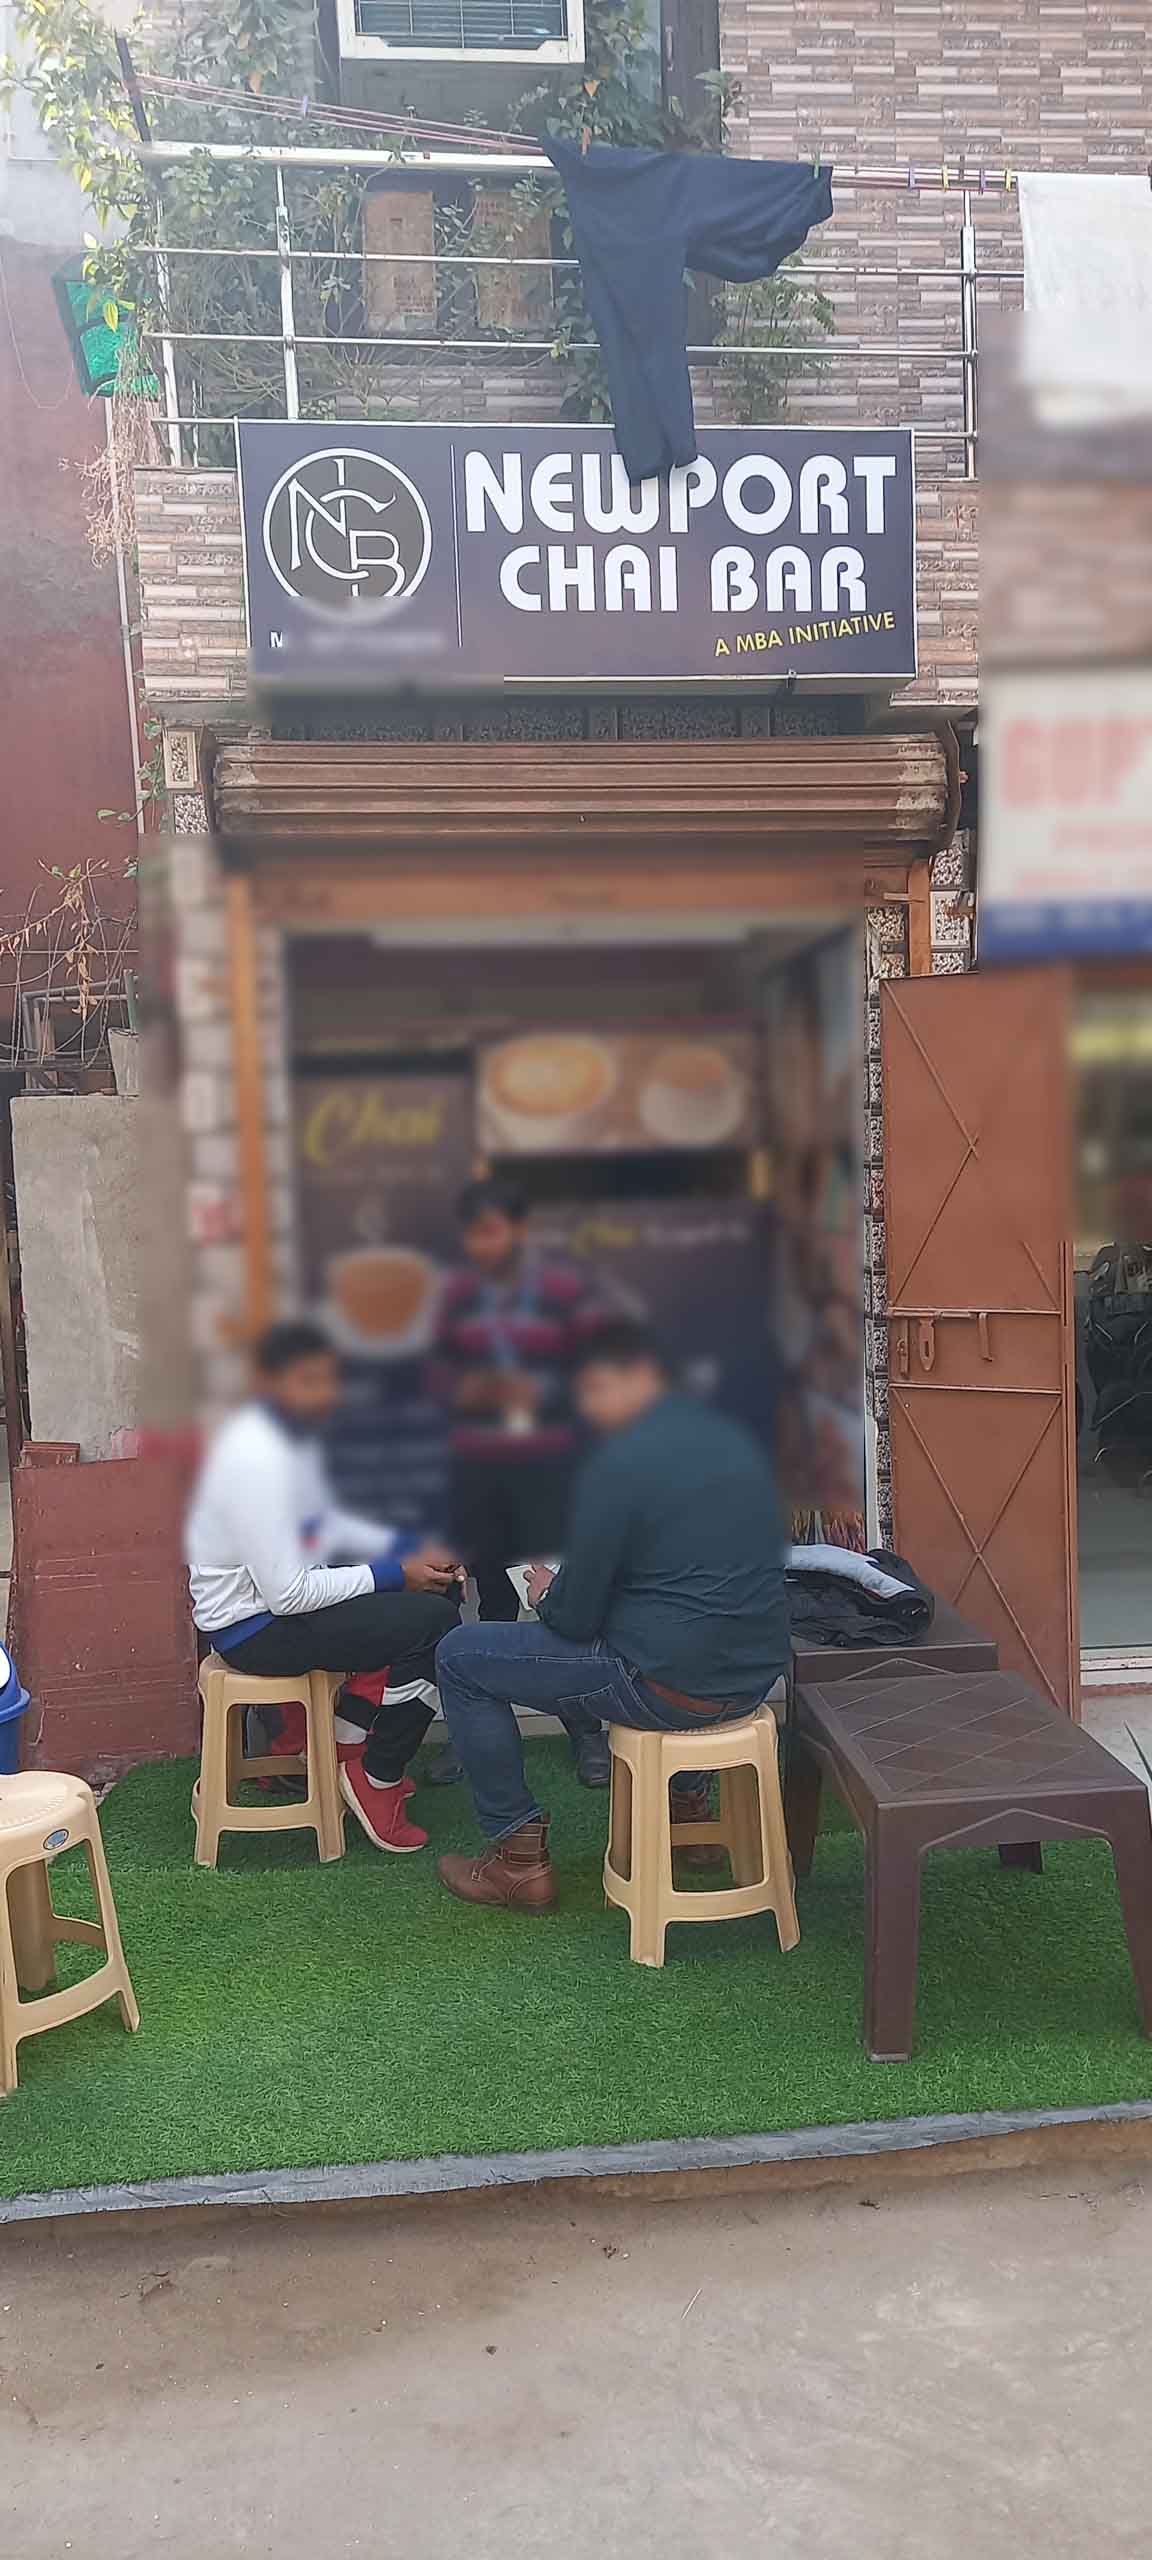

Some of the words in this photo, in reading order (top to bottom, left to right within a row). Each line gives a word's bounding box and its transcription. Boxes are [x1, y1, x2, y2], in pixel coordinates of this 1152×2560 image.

[464, 451, 896, 536] NEWPORT
[499, 544, 678, 612] CHAI
[710, 545, 867, 612] BAR
[714, 638, 731, 657] A
[736, 629, 783, 653] MBA
[788, 611, 896, 645] INITIATIVE
